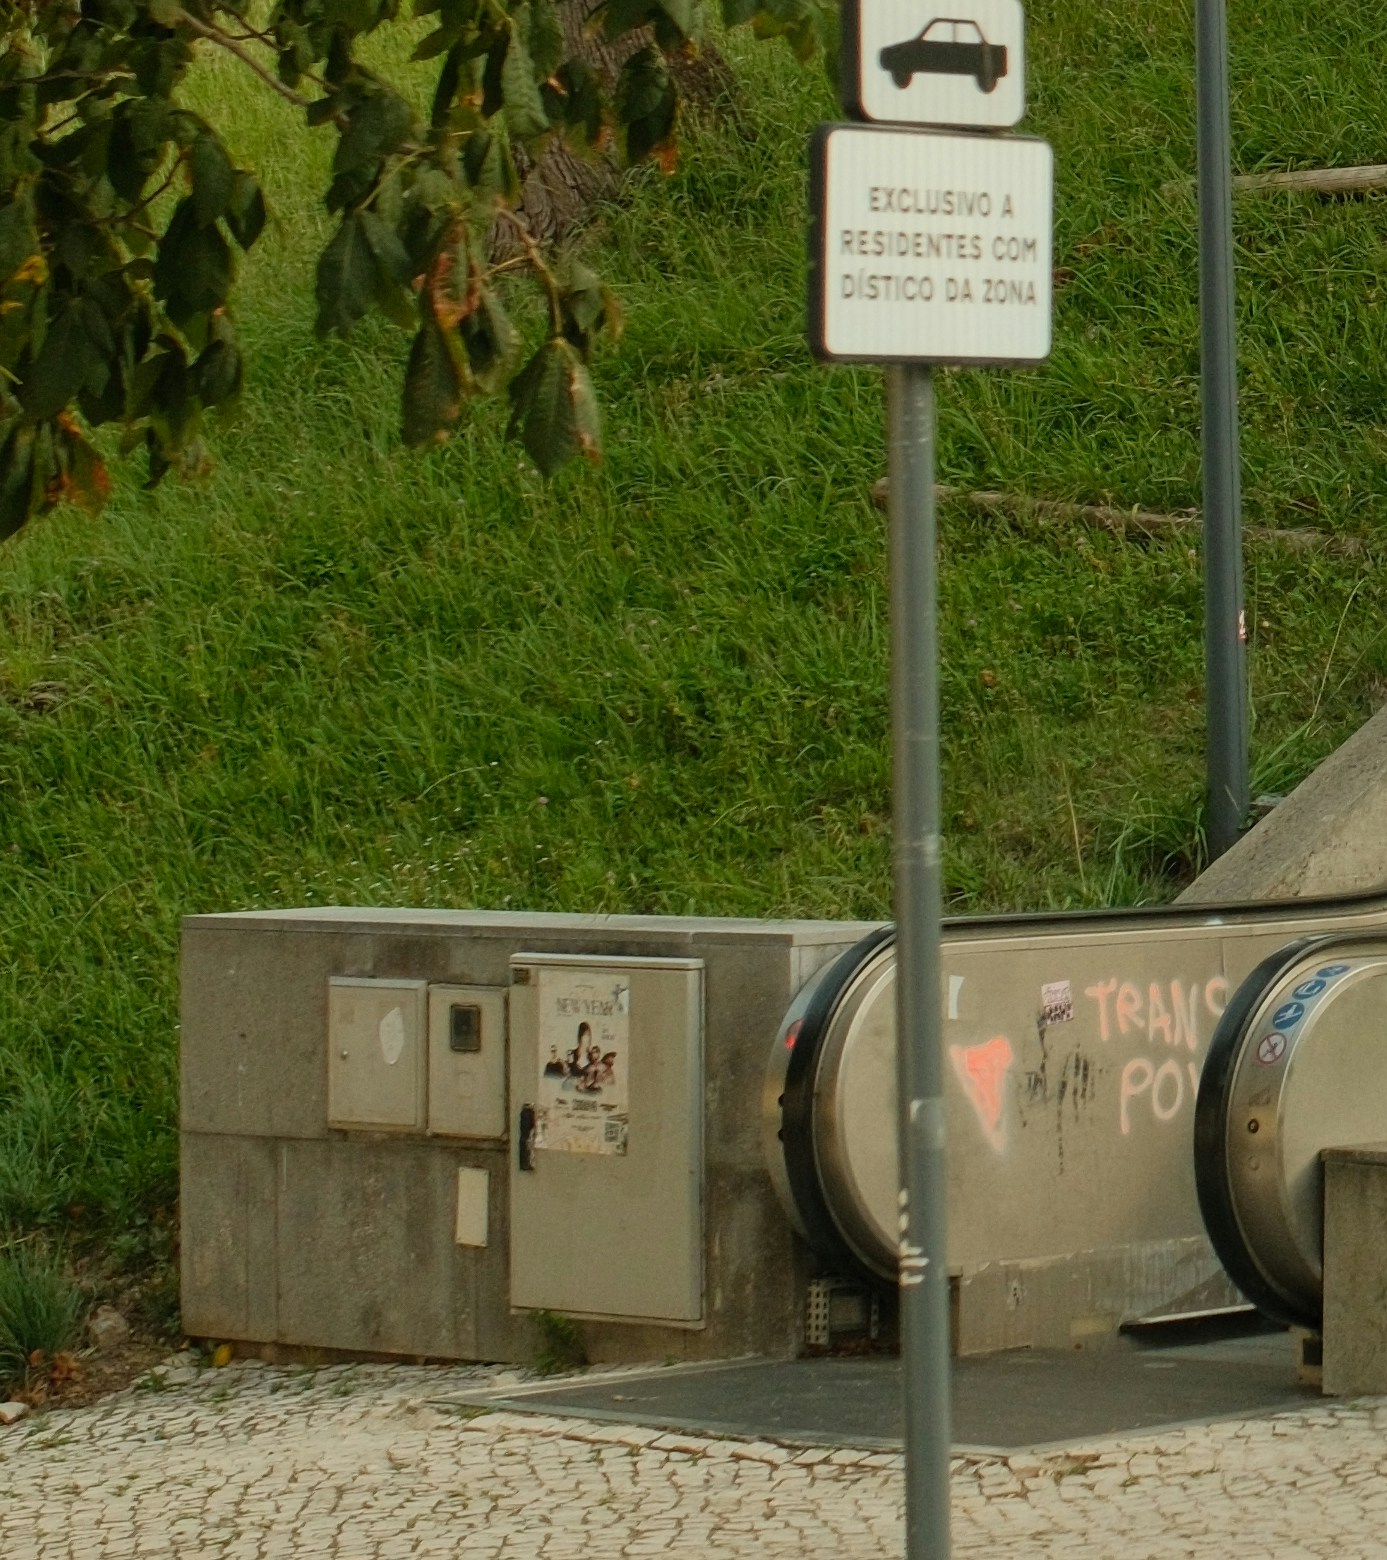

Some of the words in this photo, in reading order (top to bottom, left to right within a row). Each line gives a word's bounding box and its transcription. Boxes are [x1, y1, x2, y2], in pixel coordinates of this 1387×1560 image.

[869, 186, 992, 217] EXCLUSIVO
[1001, 193, 1015, 218] A
[840, 229, 982, 260] RESIDENTES
[992, 236, 1038, 262] COM
[841, 268, 934, 301] DÍSTICO
[945, 277, 974, 303] DA
[982, 278, 1037, 305] ZONA
